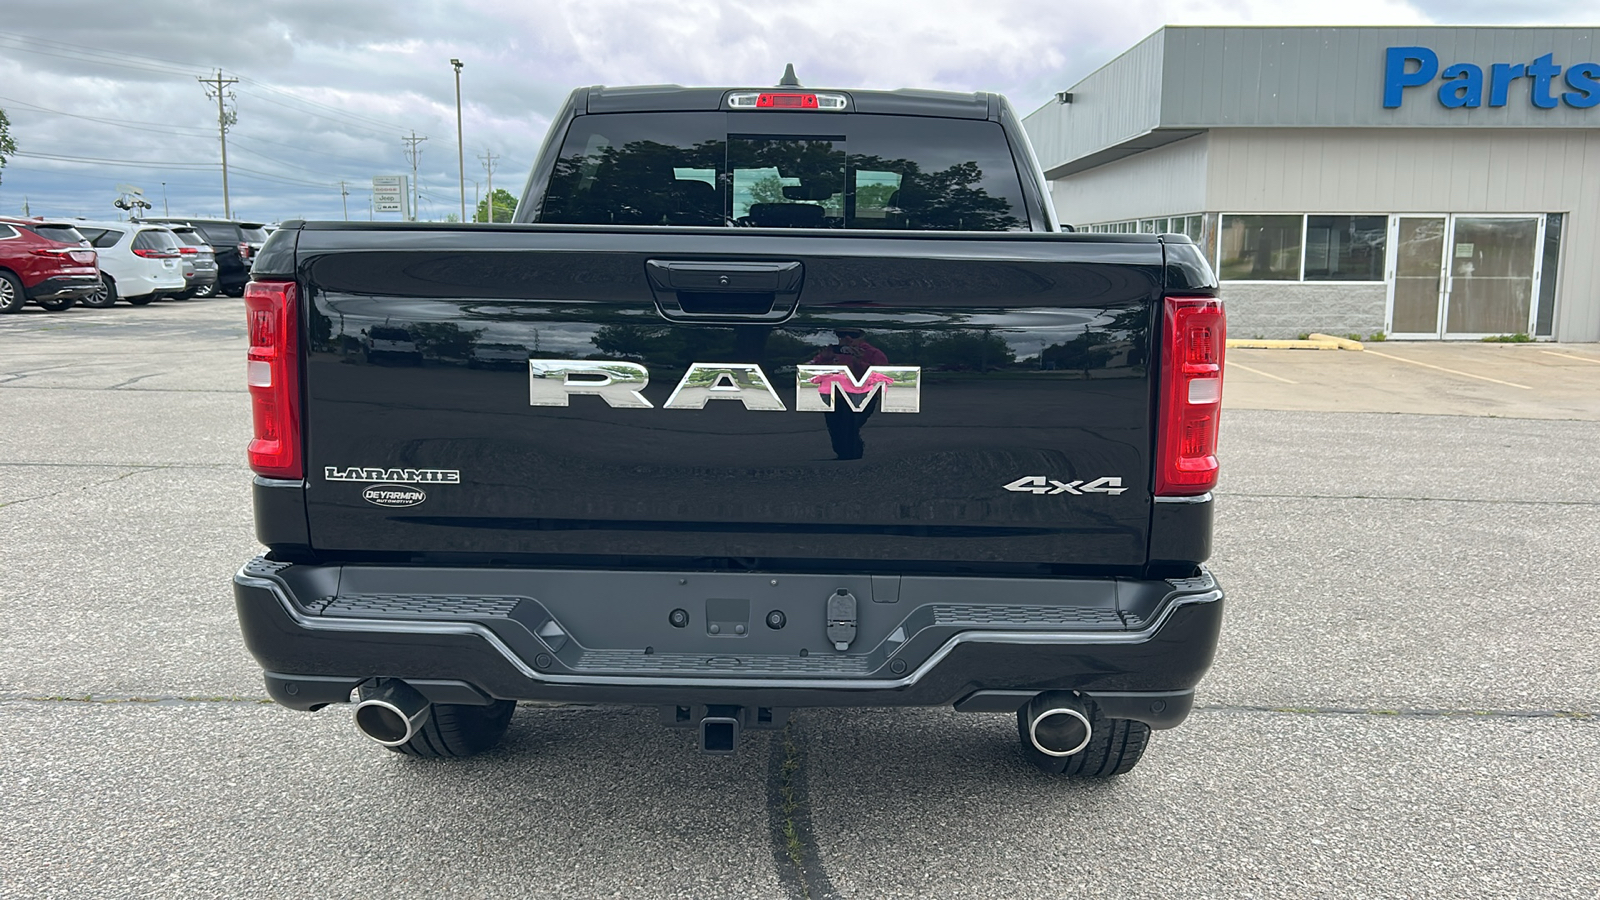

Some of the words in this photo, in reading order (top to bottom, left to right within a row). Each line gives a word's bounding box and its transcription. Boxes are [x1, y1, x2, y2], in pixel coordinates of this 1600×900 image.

[1383, 46, 1600, 109] Parts
[529, 358, 921, 413] RAM
[325, 466, 460, 484] LARAMIE
[365, 490, 423, 500] DEYARMAN
[1002, 476, 1129, 495] 4x4
